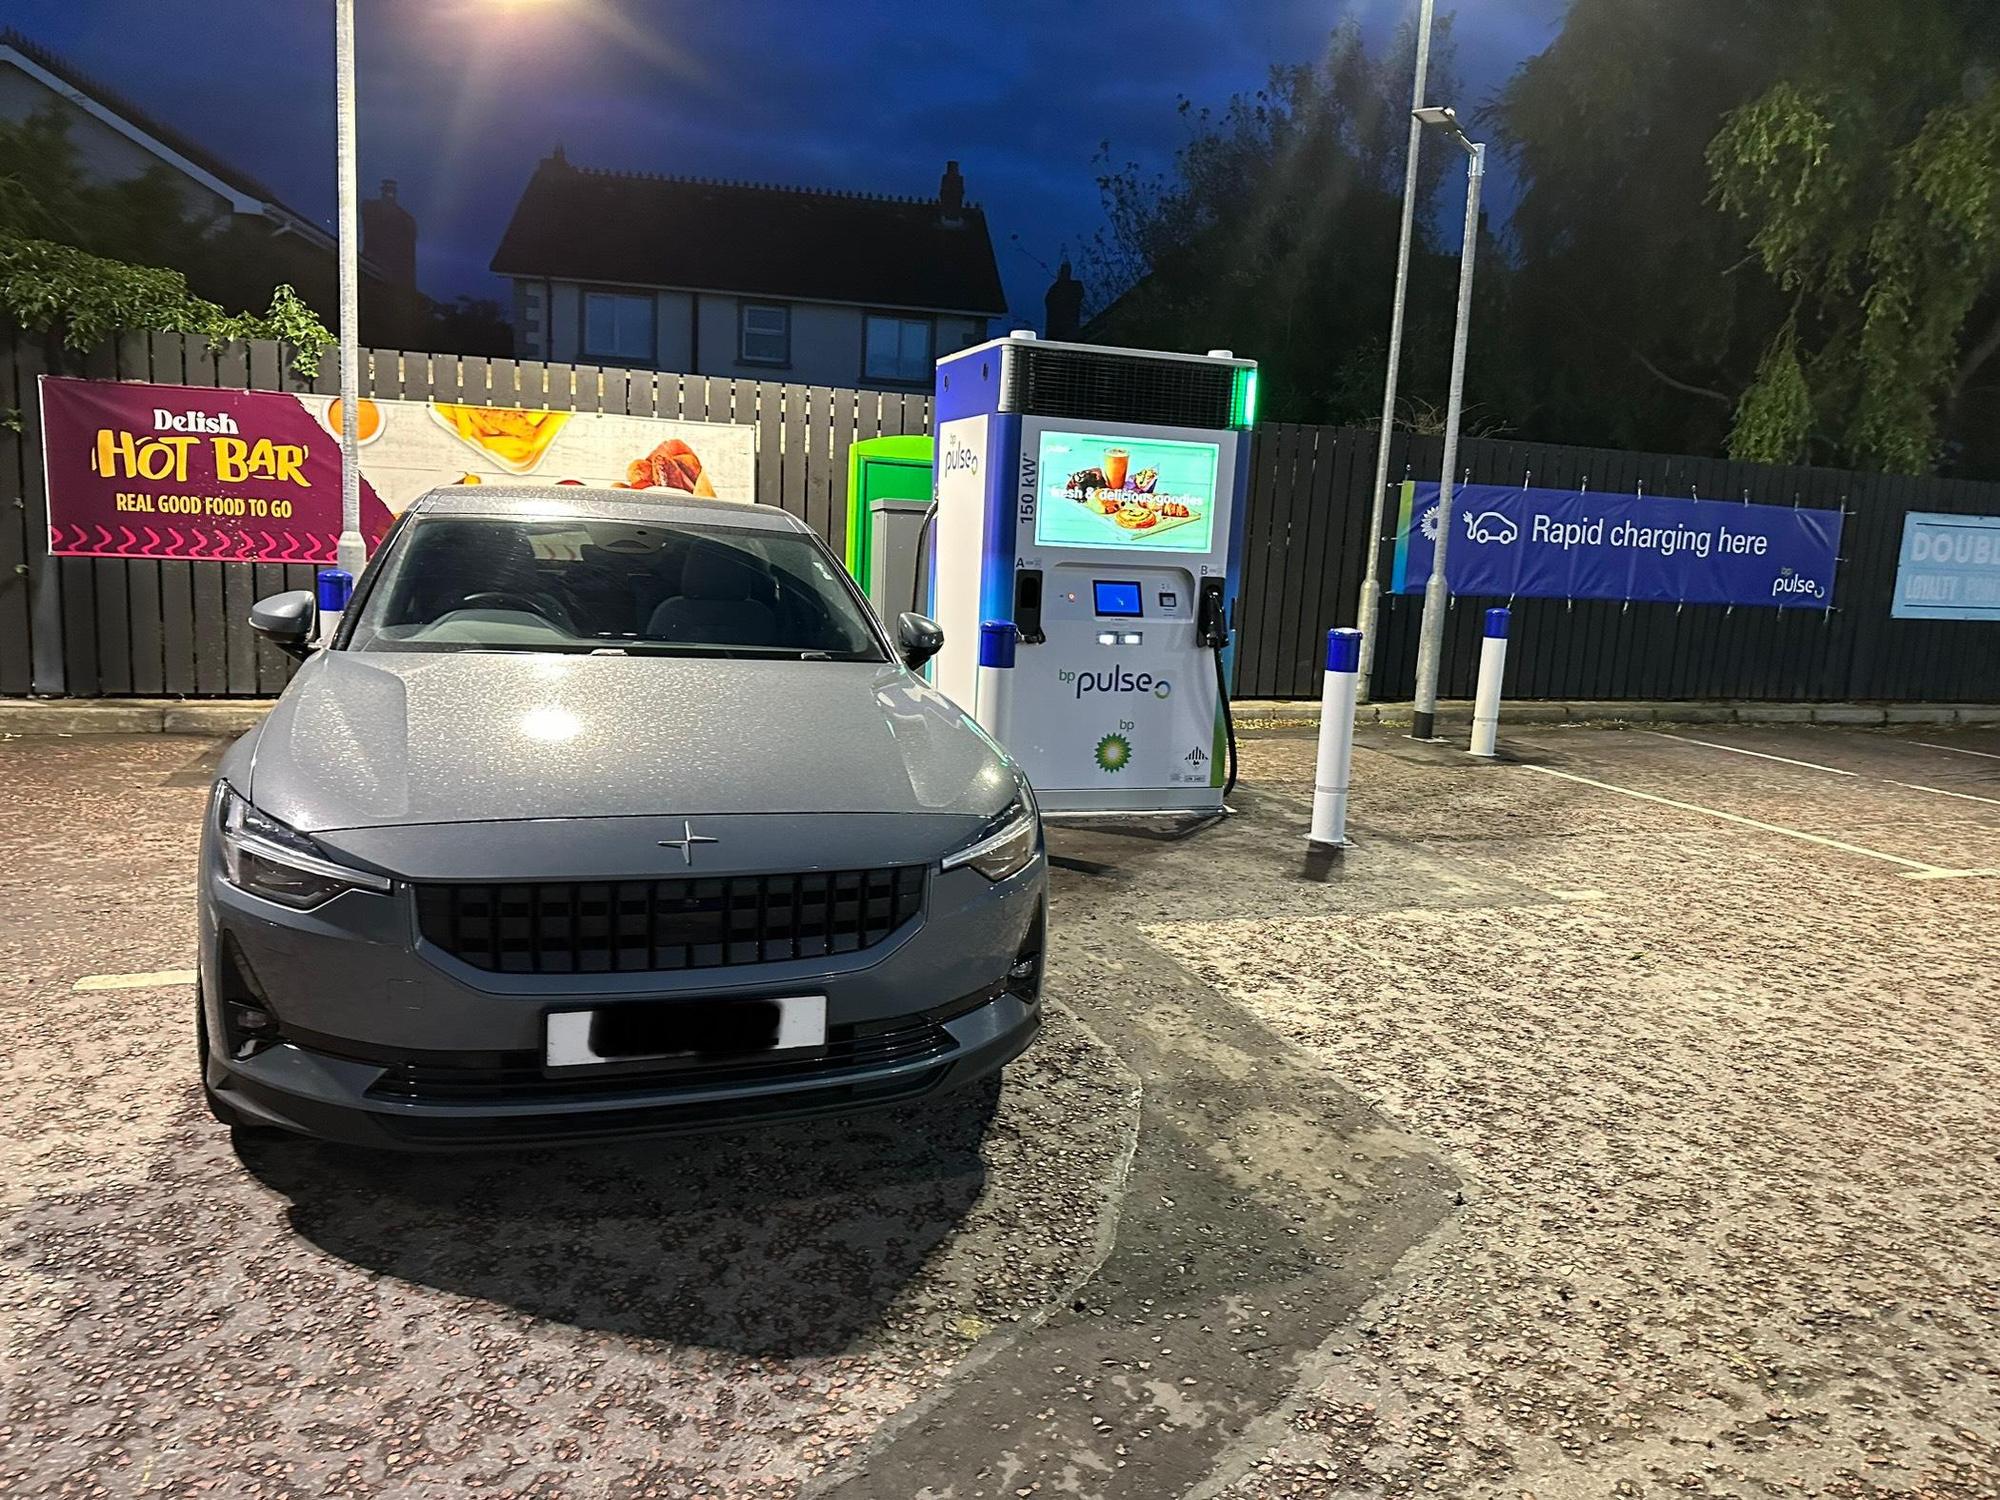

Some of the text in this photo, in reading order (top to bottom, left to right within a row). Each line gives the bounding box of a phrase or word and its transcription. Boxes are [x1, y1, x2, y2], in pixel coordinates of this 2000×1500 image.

[154, 409, 239, 435] Delish
[96, 429, 312, 488] HOT BAR
[945, 440, 972, 478] pulse
[116, 493, 293, 519] REAL GOOD FOOD TO GO
[1020, 493, 1034, 524] 150
[1099, 488, 1153, 503] delicious
[1532, 514, 1768, 558] Rapid charging here
[1016, 557, 1025, 568] A
[1200, 565, 1208, 575] B
[1772, 573, 1816, 597] pulse
[1059, 664, 1153, 699] bp pulse
[1119, 719, 1135, 731] bp
